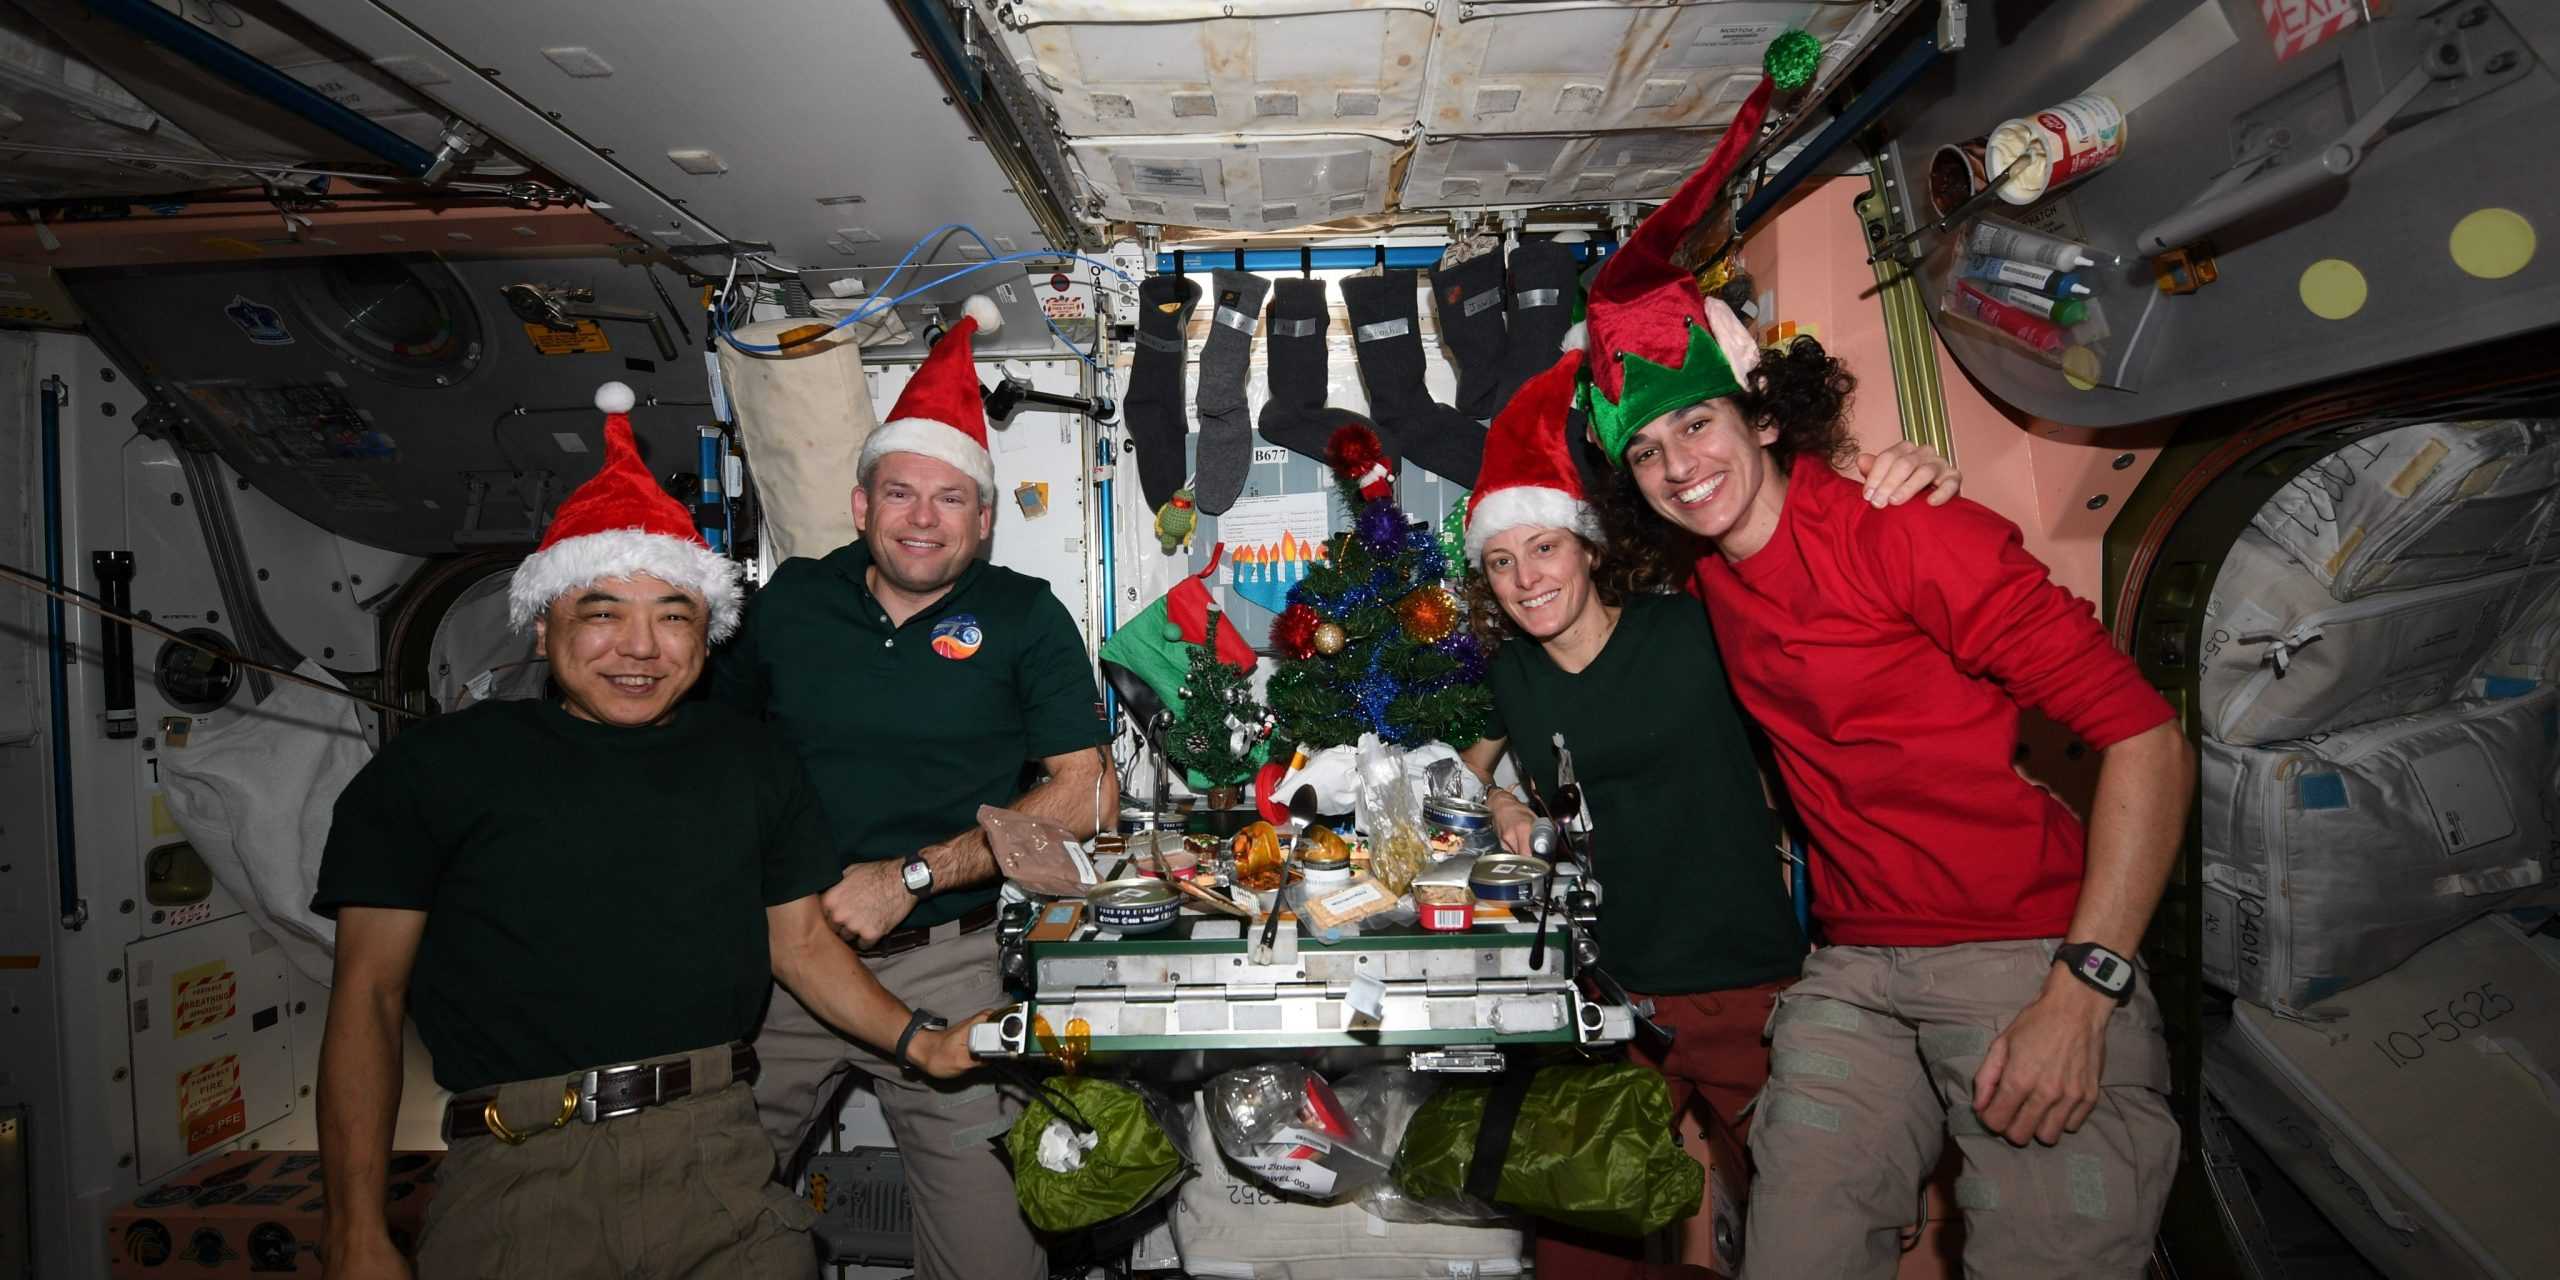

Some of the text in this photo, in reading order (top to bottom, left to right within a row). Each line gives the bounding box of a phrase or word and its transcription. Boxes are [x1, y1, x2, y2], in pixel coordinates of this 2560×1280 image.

[2275, 0, 2347, 35] EX
[1255, 450, 1287, 461] B677
[183, 993, 230, 1010] BREATHING
[200, 1080, 224, 1094] FIRE
[217, 1112, 241, 1129] PFE
[1267, 1162, 1302, 1172] Ziplock
[1263, 1174, 1311, 1190] WEL-003
